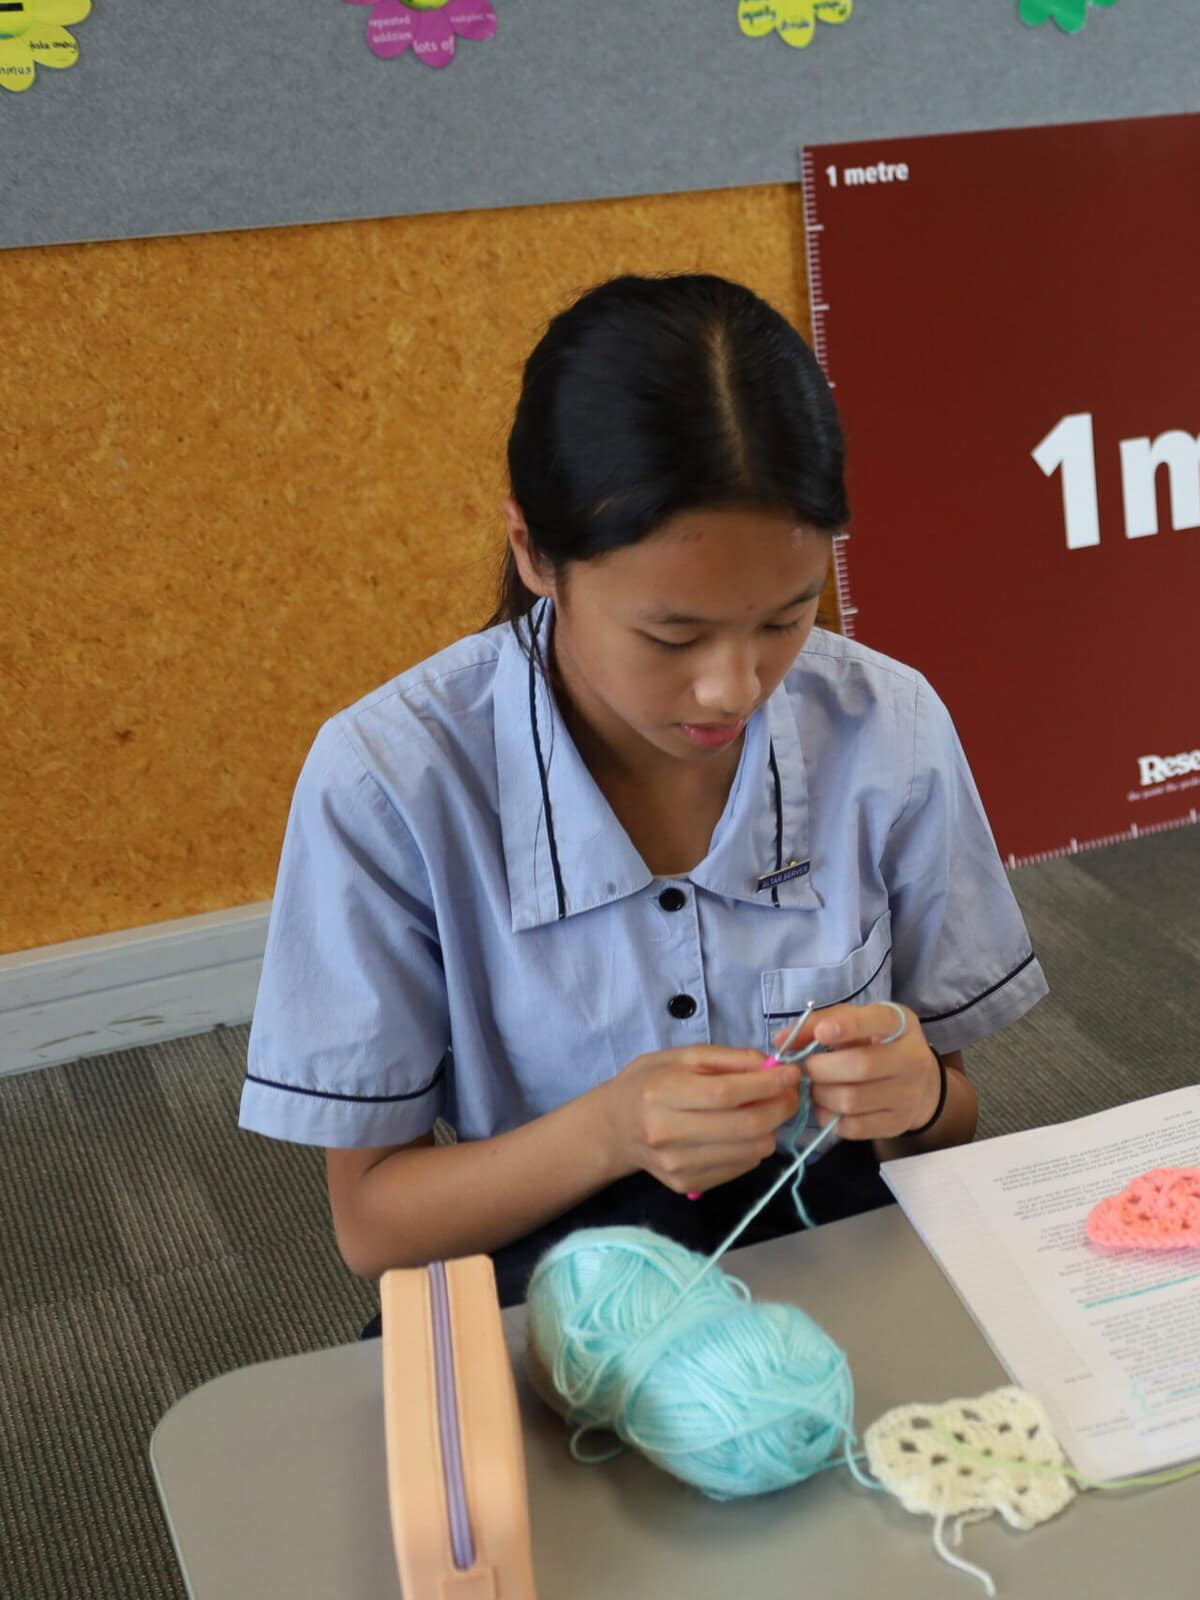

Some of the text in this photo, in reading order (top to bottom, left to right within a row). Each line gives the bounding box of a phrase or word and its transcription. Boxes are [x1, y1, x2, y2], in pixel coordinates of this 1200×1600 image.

[412, 34, 456, 56] lots of
[825, 160, 909, 188] 1 metre
